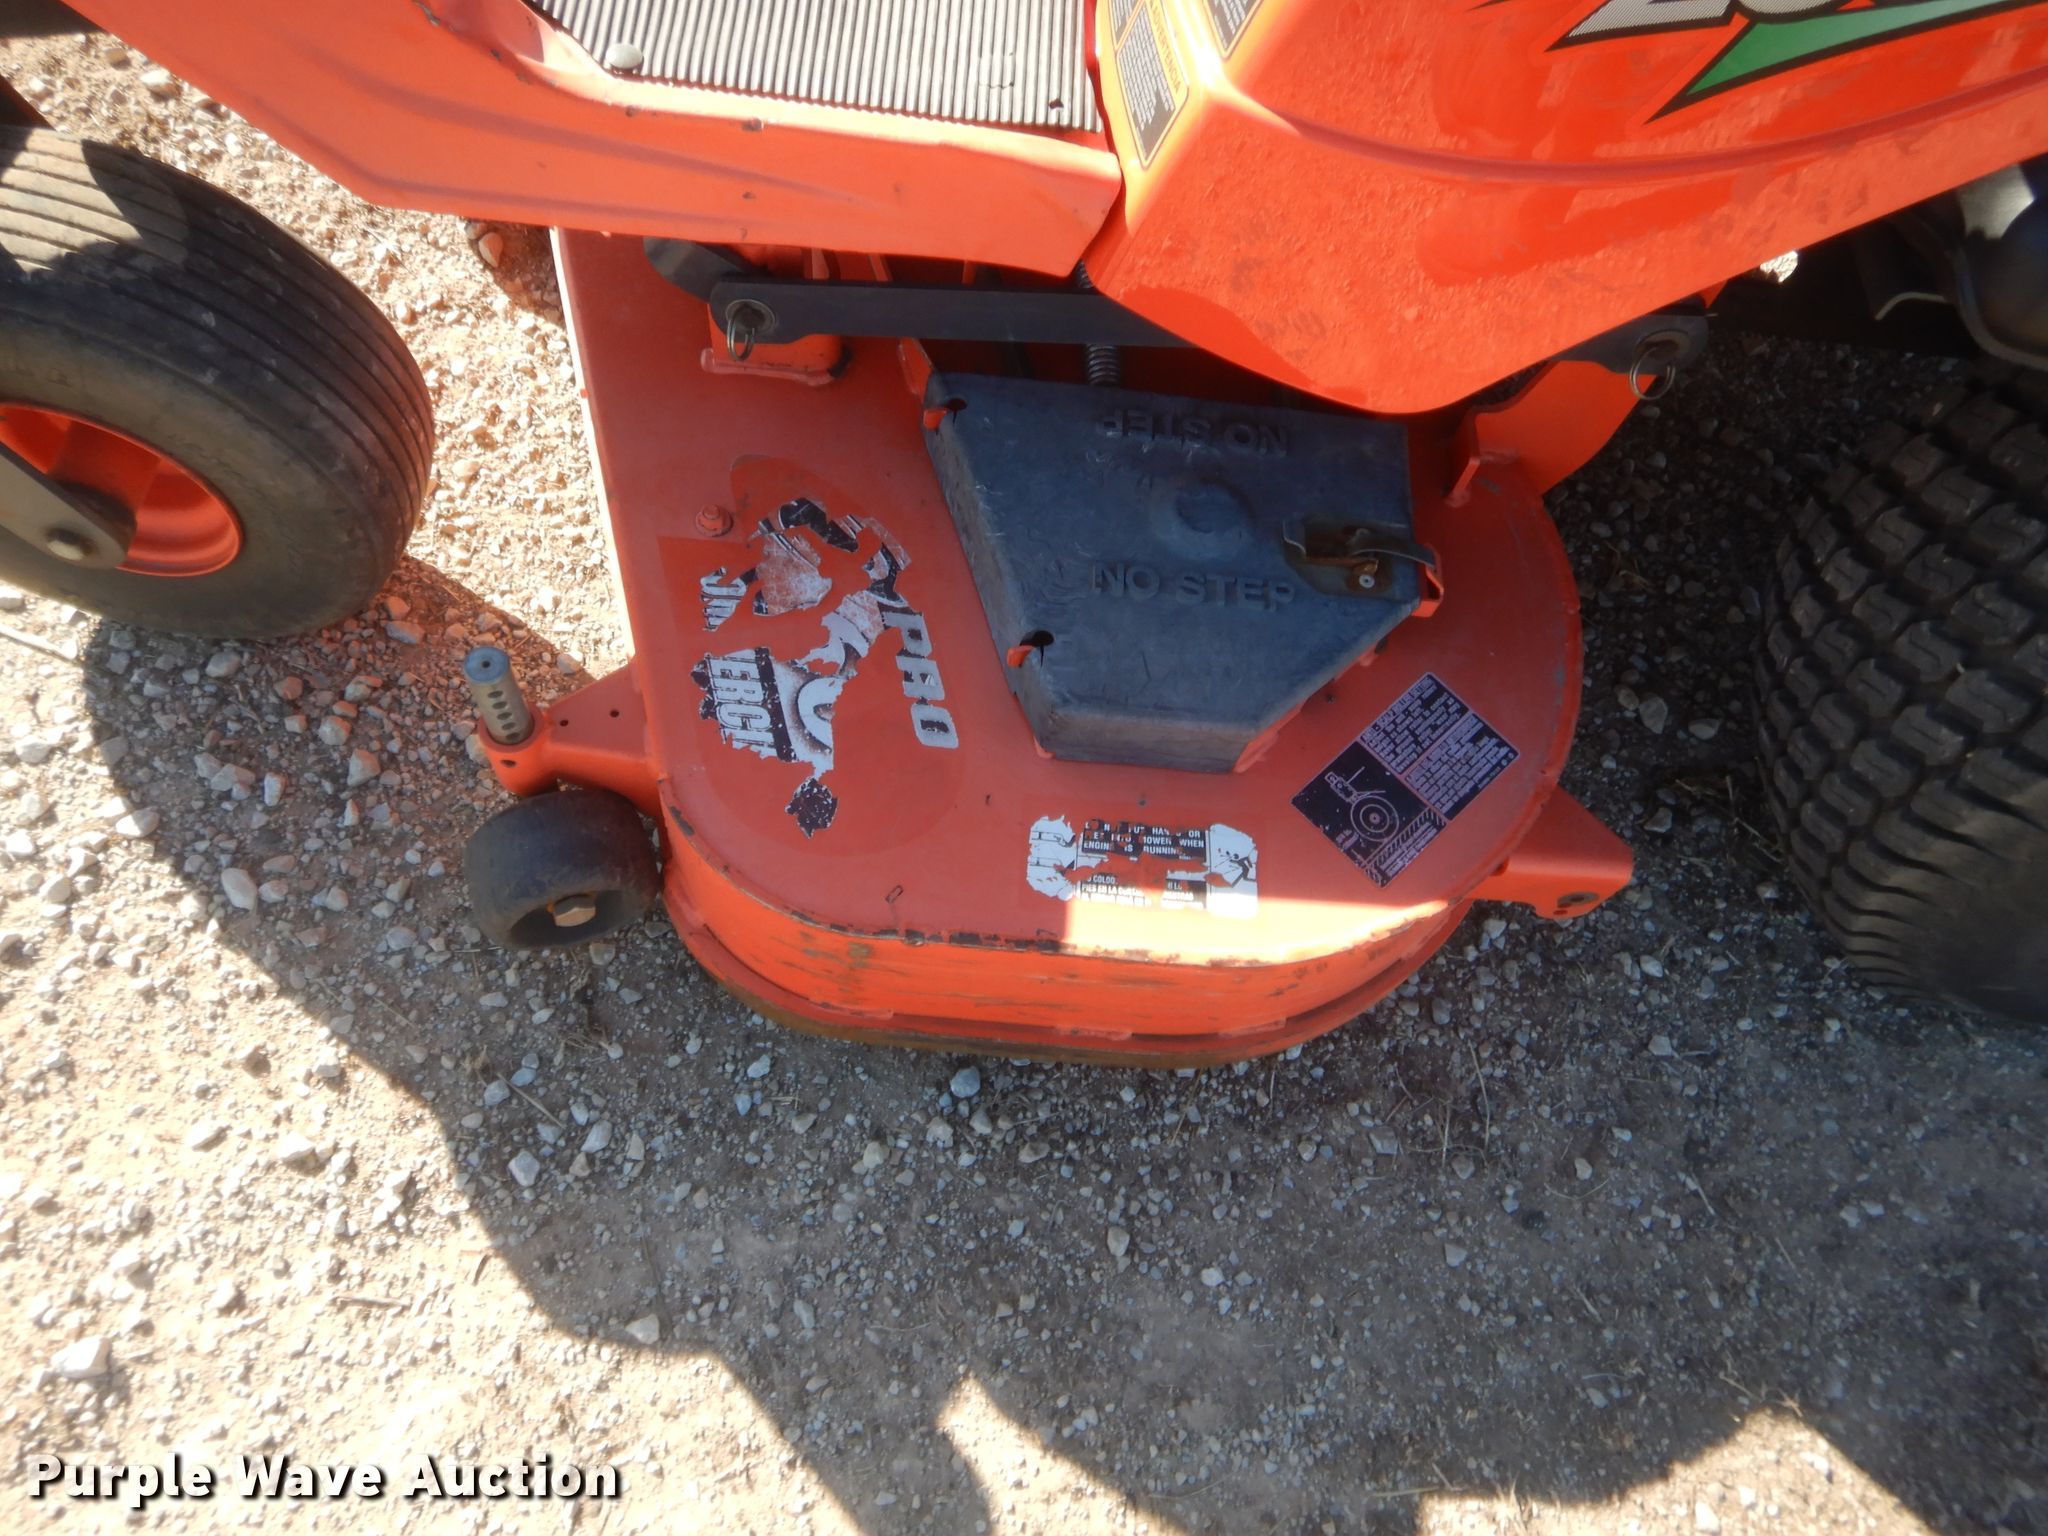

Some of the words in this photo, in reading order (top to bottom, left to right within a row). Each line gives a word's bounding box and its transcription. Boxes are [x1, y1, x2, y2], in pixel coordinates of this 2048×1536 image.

[1092, 561, 1160, 600] NO
[1176, 573, 1296, 612] STEP
[1188, 830, 1200, 838] OR
[1179, 839, 1205, 849] WHEN
